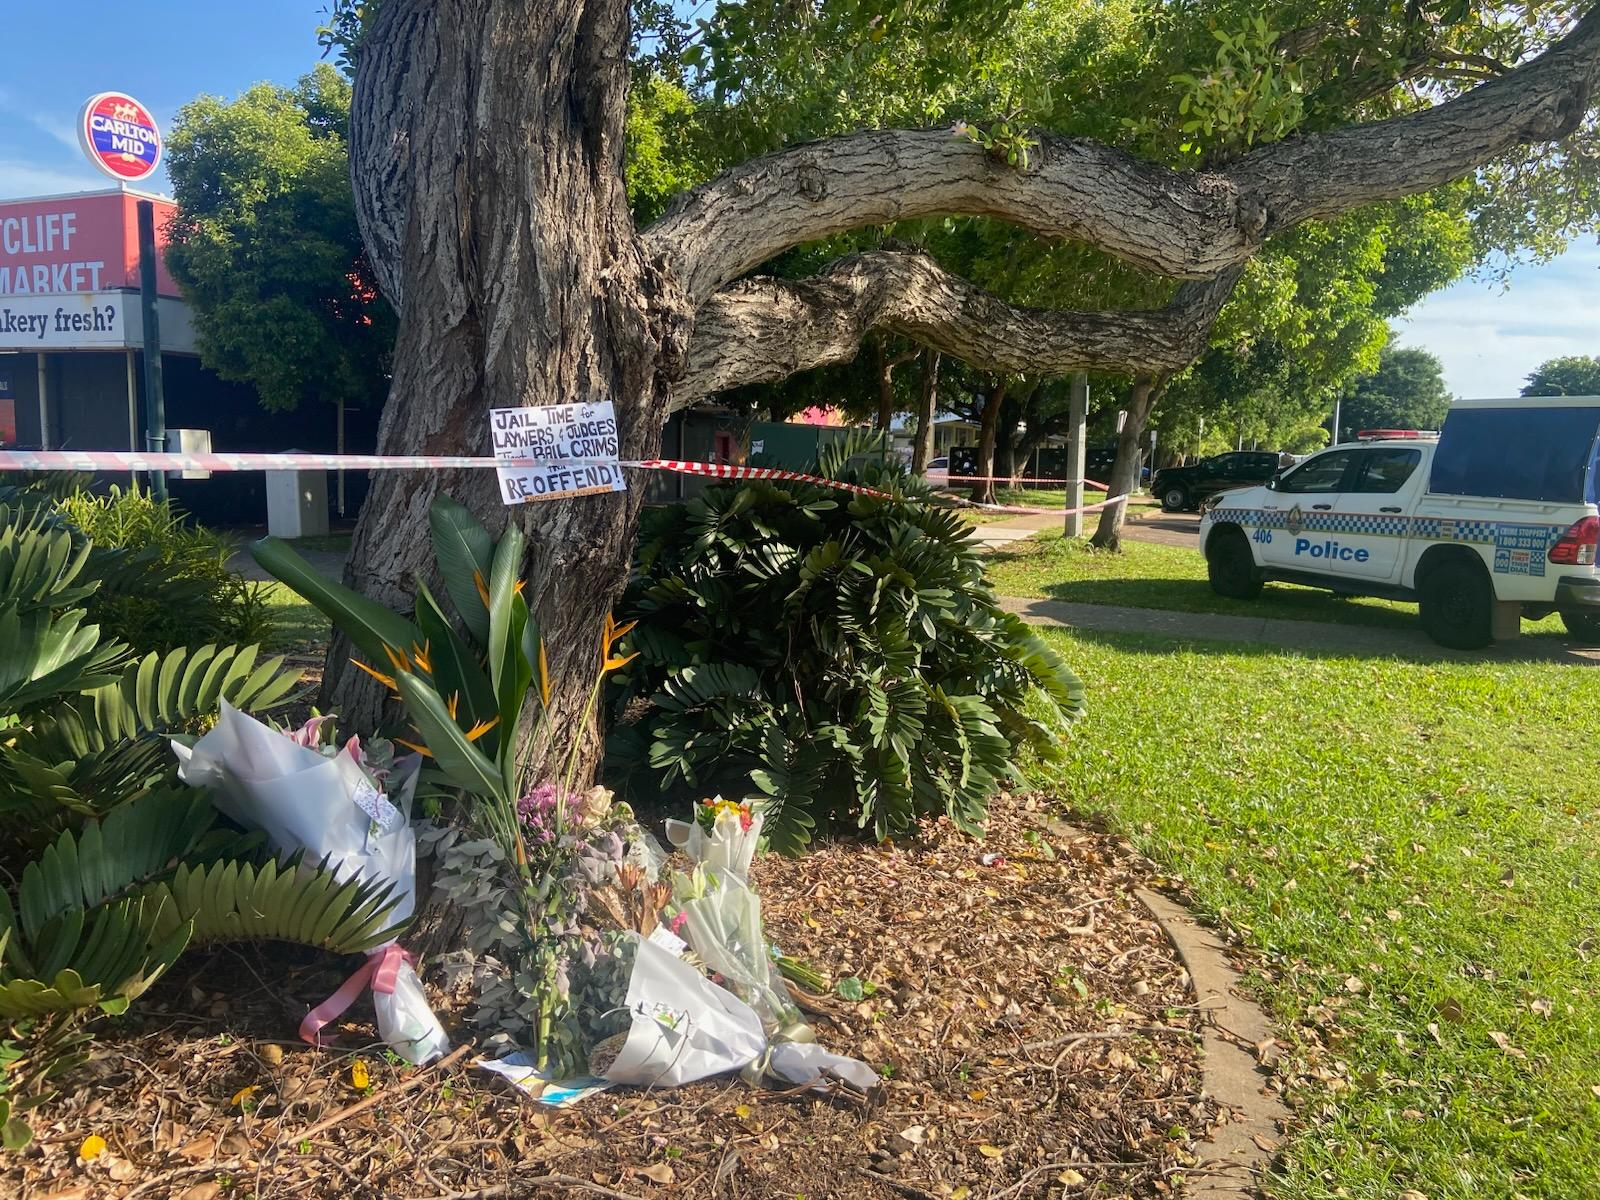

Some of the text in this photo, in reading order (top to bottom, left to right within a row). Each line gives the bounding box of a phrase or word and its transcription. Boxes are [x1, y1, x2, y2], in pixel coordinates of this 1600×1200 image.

[91, 115, 158, 146] CARLTON
[112, 135, 145, 156] MID
[0, 212, 77, 255] CLIFF
[55, 305, 116, 332] fresh?
[495, 410, 537, 430] JAIL
[580, 407, 595, 419] for
[493, 426, 554, 448] LAYWERS
[565, 419, 616, 440] JUDGES
[533, 443, 570, 460] BAIL
[570, 437, 617, 458] CRIMS
[1252, 528, 1273, 545] 406
[1295, 538, 1370, 562] Police
